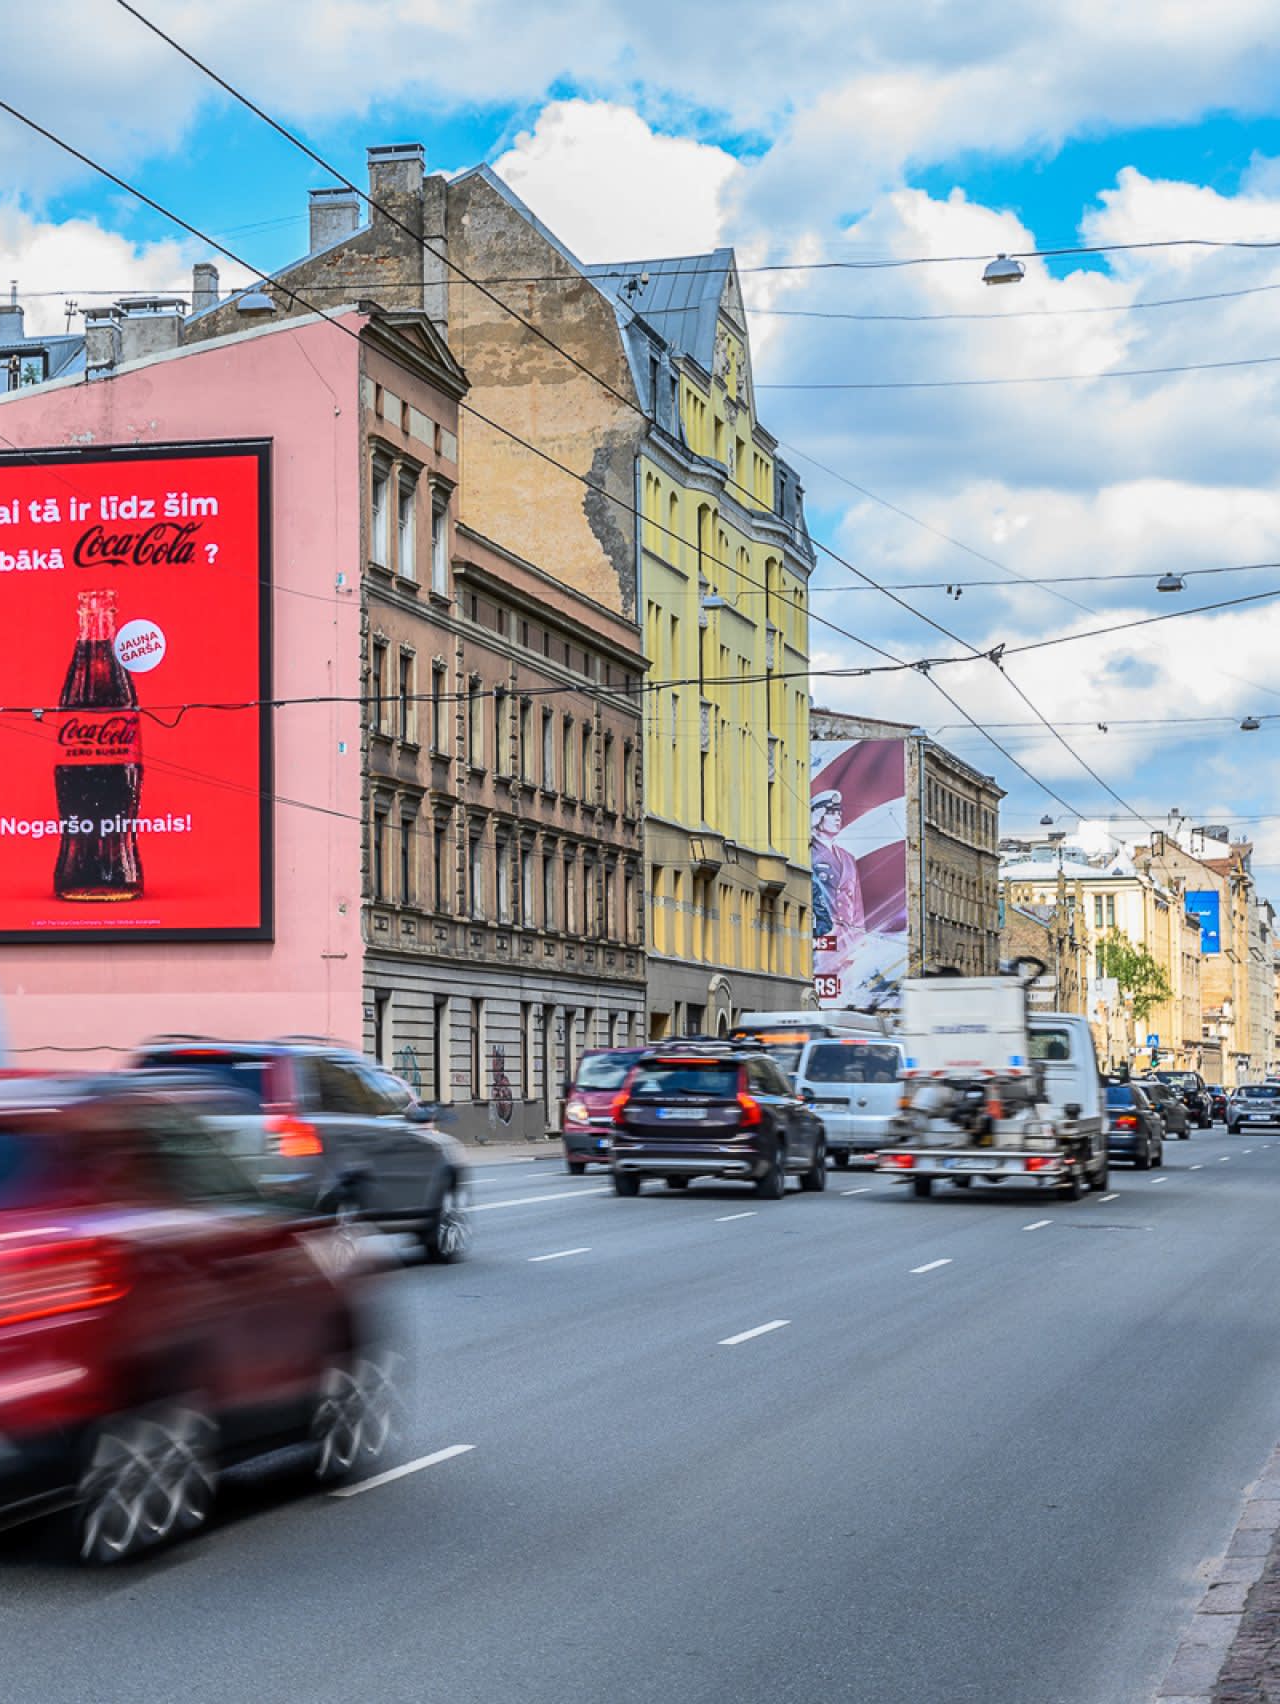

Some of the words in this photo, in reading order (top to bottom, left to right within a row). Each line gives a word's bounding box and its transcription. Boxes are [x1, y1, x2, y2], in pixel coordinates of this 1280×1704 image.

[28, 498, 61, 523] tā
[69, 497, 91, 521] ir
[100, 496, 156, 520] līdz
[164, 492, 219, 518] šim
[73, 522, 203, 568] Coca-Cola
[120, 631, 159, 652] JAUNA
[121, 641, 162, 662] GARŠA
[66, 748, 93, 758] ZERO
[0, 815, 94, 839] Nogaršo
[100, 813, 192, 838] pirmais!
